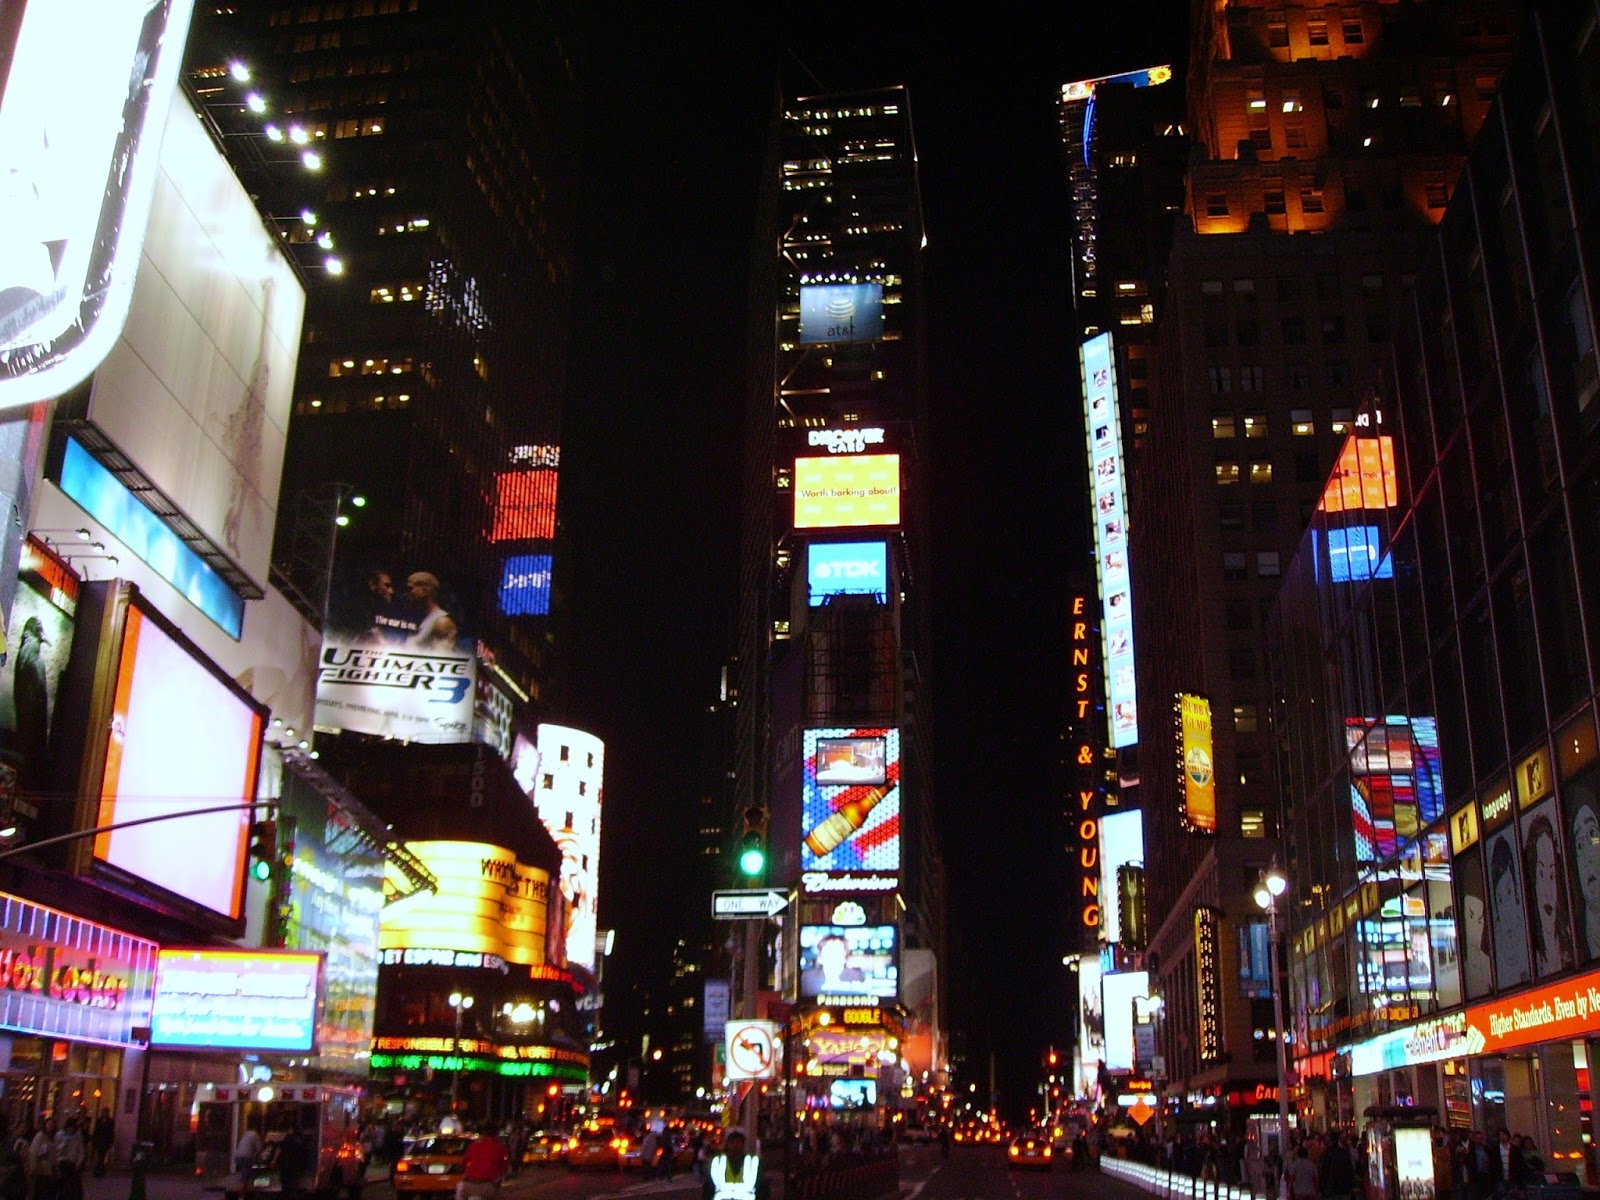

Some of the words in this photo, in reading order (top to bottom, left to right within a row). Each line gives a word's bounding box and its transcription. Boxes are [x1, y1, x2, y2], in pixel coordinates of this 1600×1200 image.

[827, 325, 856, 337] at&t
[828, 443, 866, 453] CARD
[801, 488, 829, 498] Worth
[831, 488, 865, 498] barking
[868, 486, 897, 495] about!
[830, 561, 881, 577] TDK
[322, 648, 470, 676] ULTIMATE
[1072, 597, 1089, 718] ERNST
[318, 668, 436, 690] FIGHTER
[428, 676, 473, 704] 3
[1182, 700, 1210, 717] BUBBA
[1185, 717, 1208, 732] GUMP
[1078, 745, 1093, 764] &
[1079, 792, 1100, 926] YOUNG
[801, 872, 899, 892] Budweiser
[723, 901, 744, 911] ONE
[758, 899, 781, 910] WAY
[816, 994, 880, 1007] Panasonic
[843, 1007, 881, 1024] GOOGLE
[1489, 1011, 1514, 1039] Higher
[1513, 1000, 1555, 1031] Standards.
[1553, 996, 1577, 1021] Even
[1574, 991, 1588, 1020] by
[377, 1036, 454, 1051] RESPONSIBLE
[813, 1036, 886, 1055] YAHOO!
